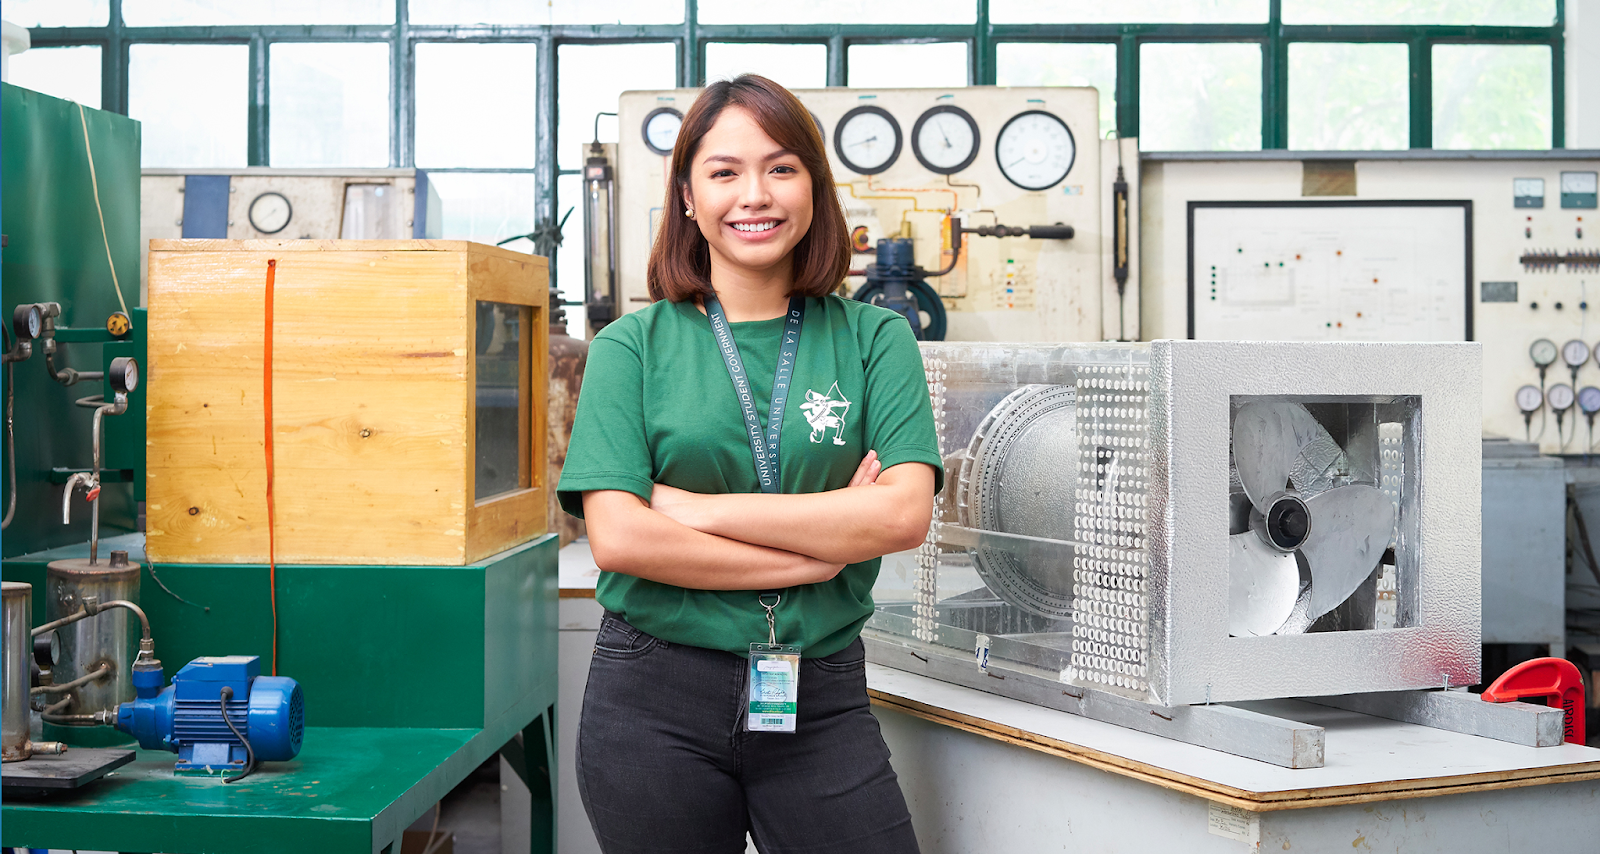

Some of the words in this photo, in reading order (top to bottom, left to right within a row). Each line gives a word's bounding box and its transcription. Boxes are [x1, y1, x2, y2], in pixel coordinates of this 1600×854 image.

[786, 330, 797, 344] LA
[790, 310, 801, 325] DE
[710, 312, 741, 373] GOVERNMENT
[777, 351, 793, 389] SALLE
[734, 375, 756, 421] STUDENT
[749, 423, 772, 486] UNIVERSITY
[769, 397, 783, 479] UNIVERSIT
